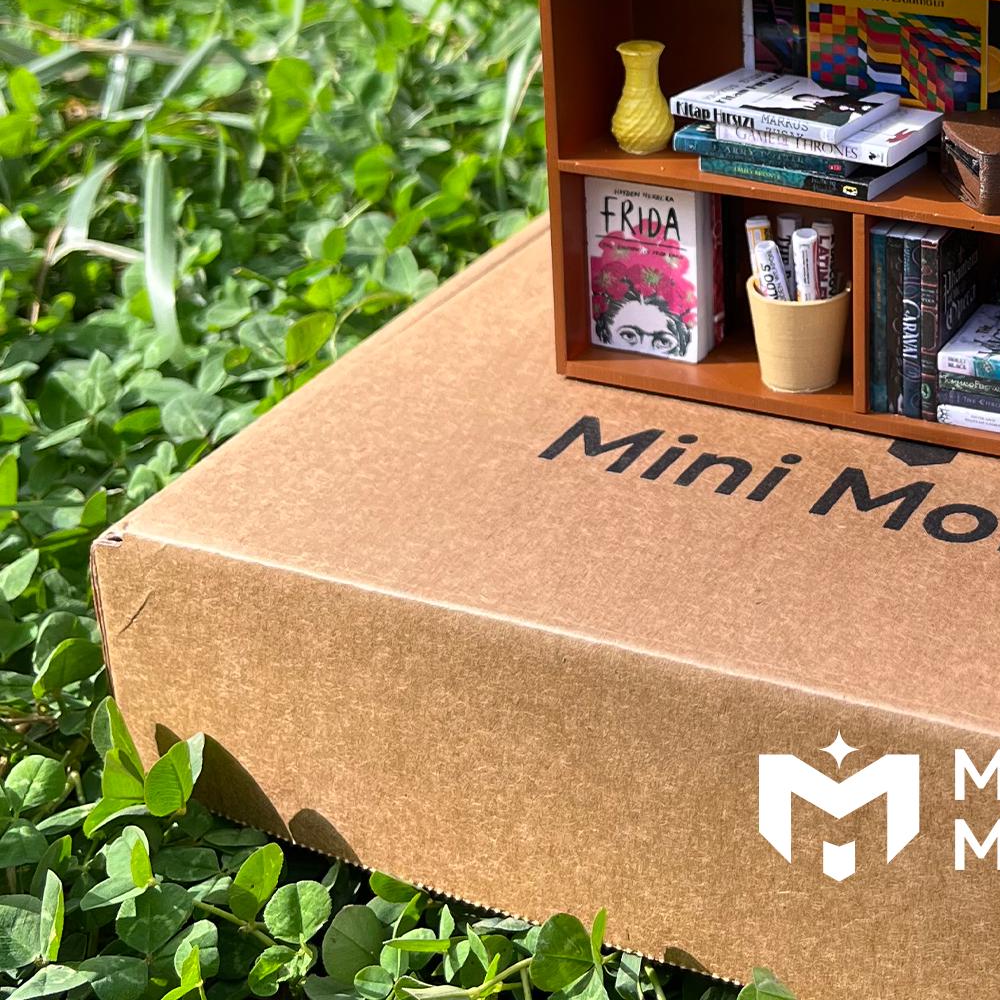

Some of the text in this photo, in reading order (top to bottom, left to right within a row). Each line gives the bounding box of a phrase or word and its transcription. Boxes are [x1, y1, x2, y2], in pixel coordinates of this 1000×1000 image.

[676, 101, 711, 119] Kitap
[761, 114, 809, 131] MARKUS
[736, 125, 775, 145] GAME
[796, 137, 858, 159] THRONES
[600, 196, 680, 241] FRIDA
[538, 414, 803, 502] Mini
